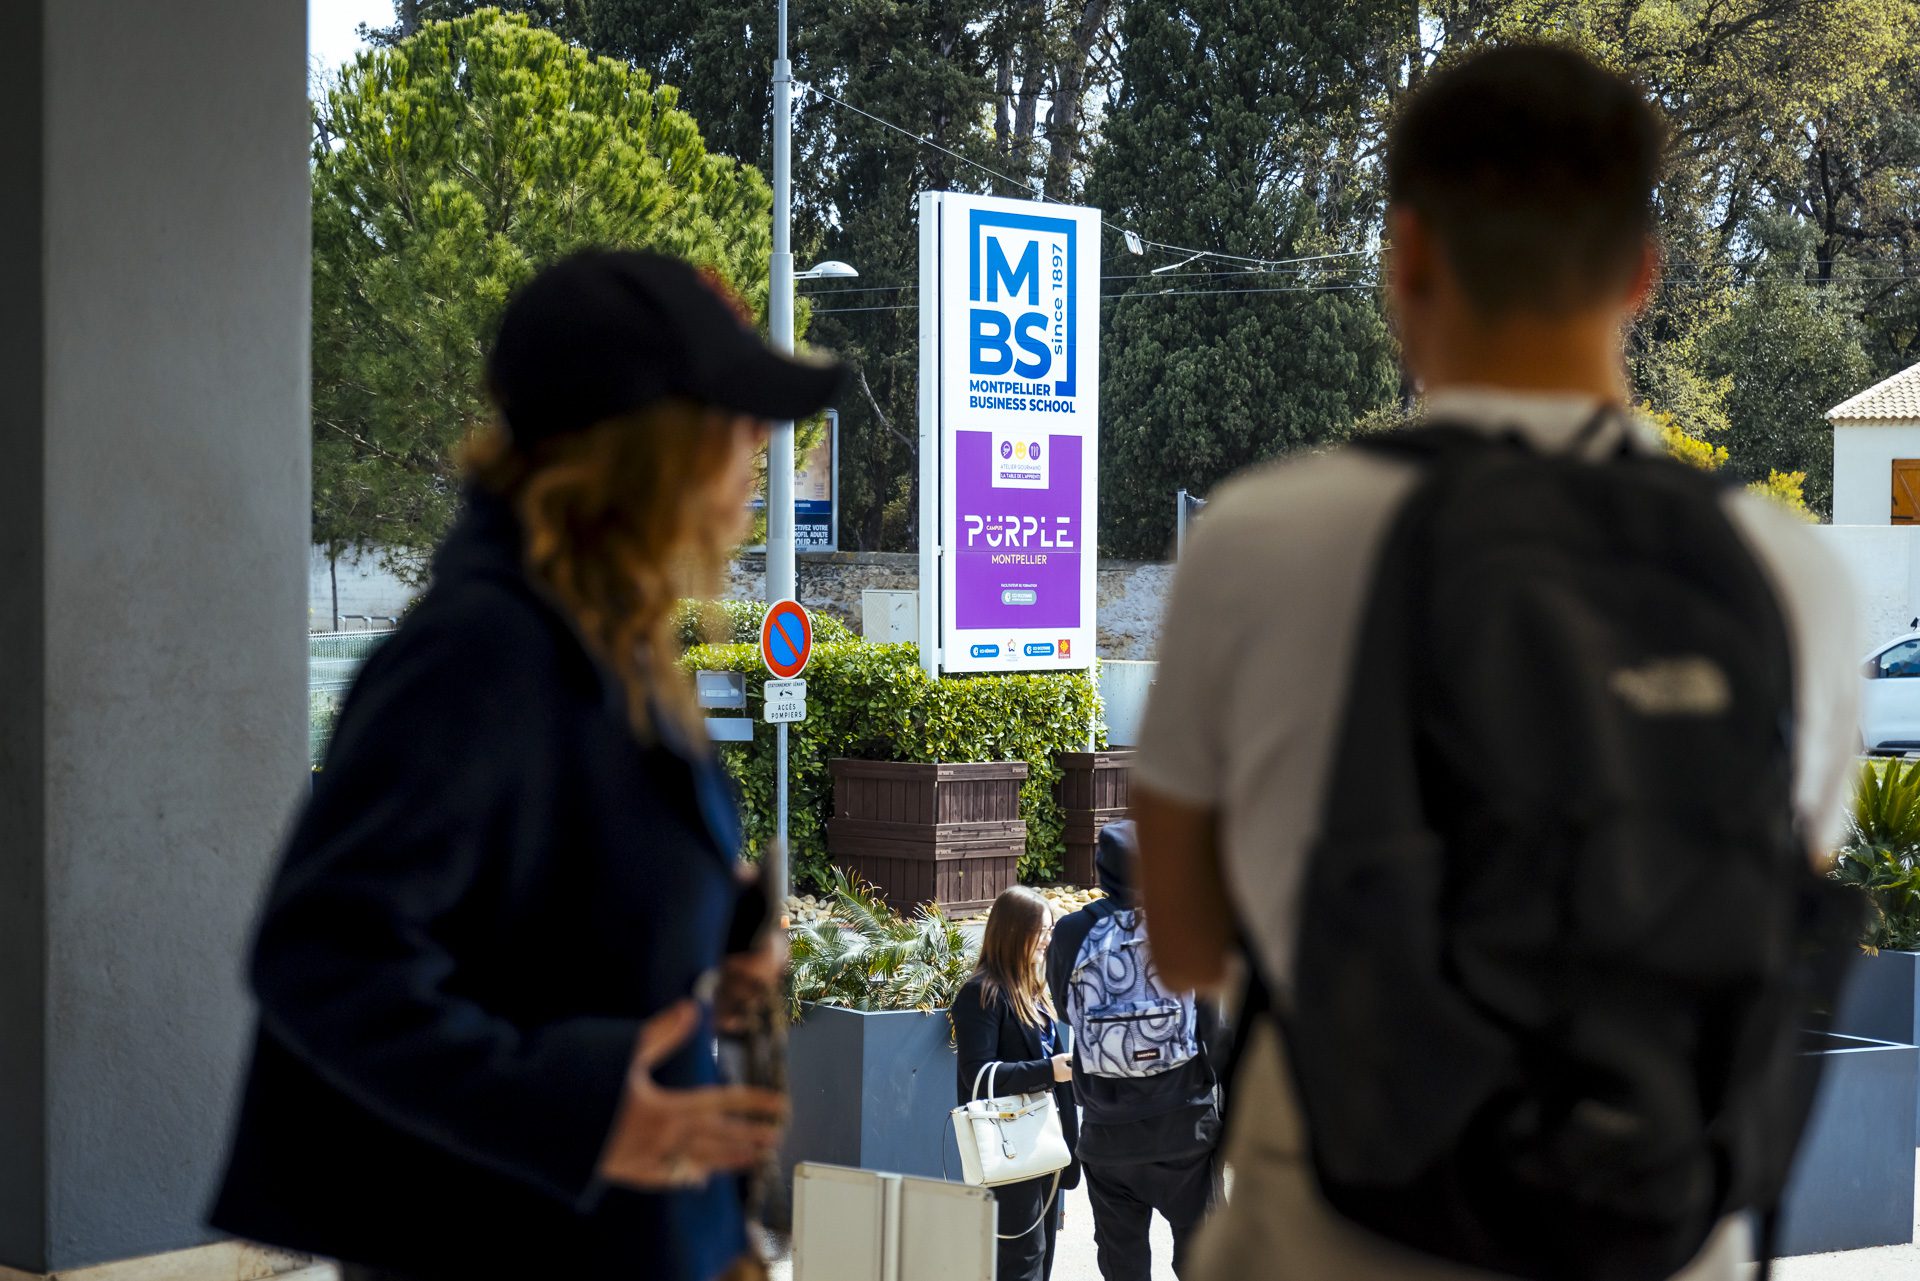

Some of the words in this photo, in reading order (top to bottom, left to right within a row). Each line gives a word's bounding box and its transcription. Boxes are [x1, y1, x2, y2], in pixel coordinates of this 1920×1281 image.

[1052, 243, 1063, 289] 1897
[1052, 297, 1063, 355] since
[970, 380, 1050, 396] MONTPELLIER
[970, 396, 1026, 411] BUSINESS
[1029, 398, 1076, 413] SCHOOL
[964, 515, 1074, 547] PURPLE
[991, 554, 1047, 565] MONTPELLIER
[771, 711, 802, 719] POMPIERS
